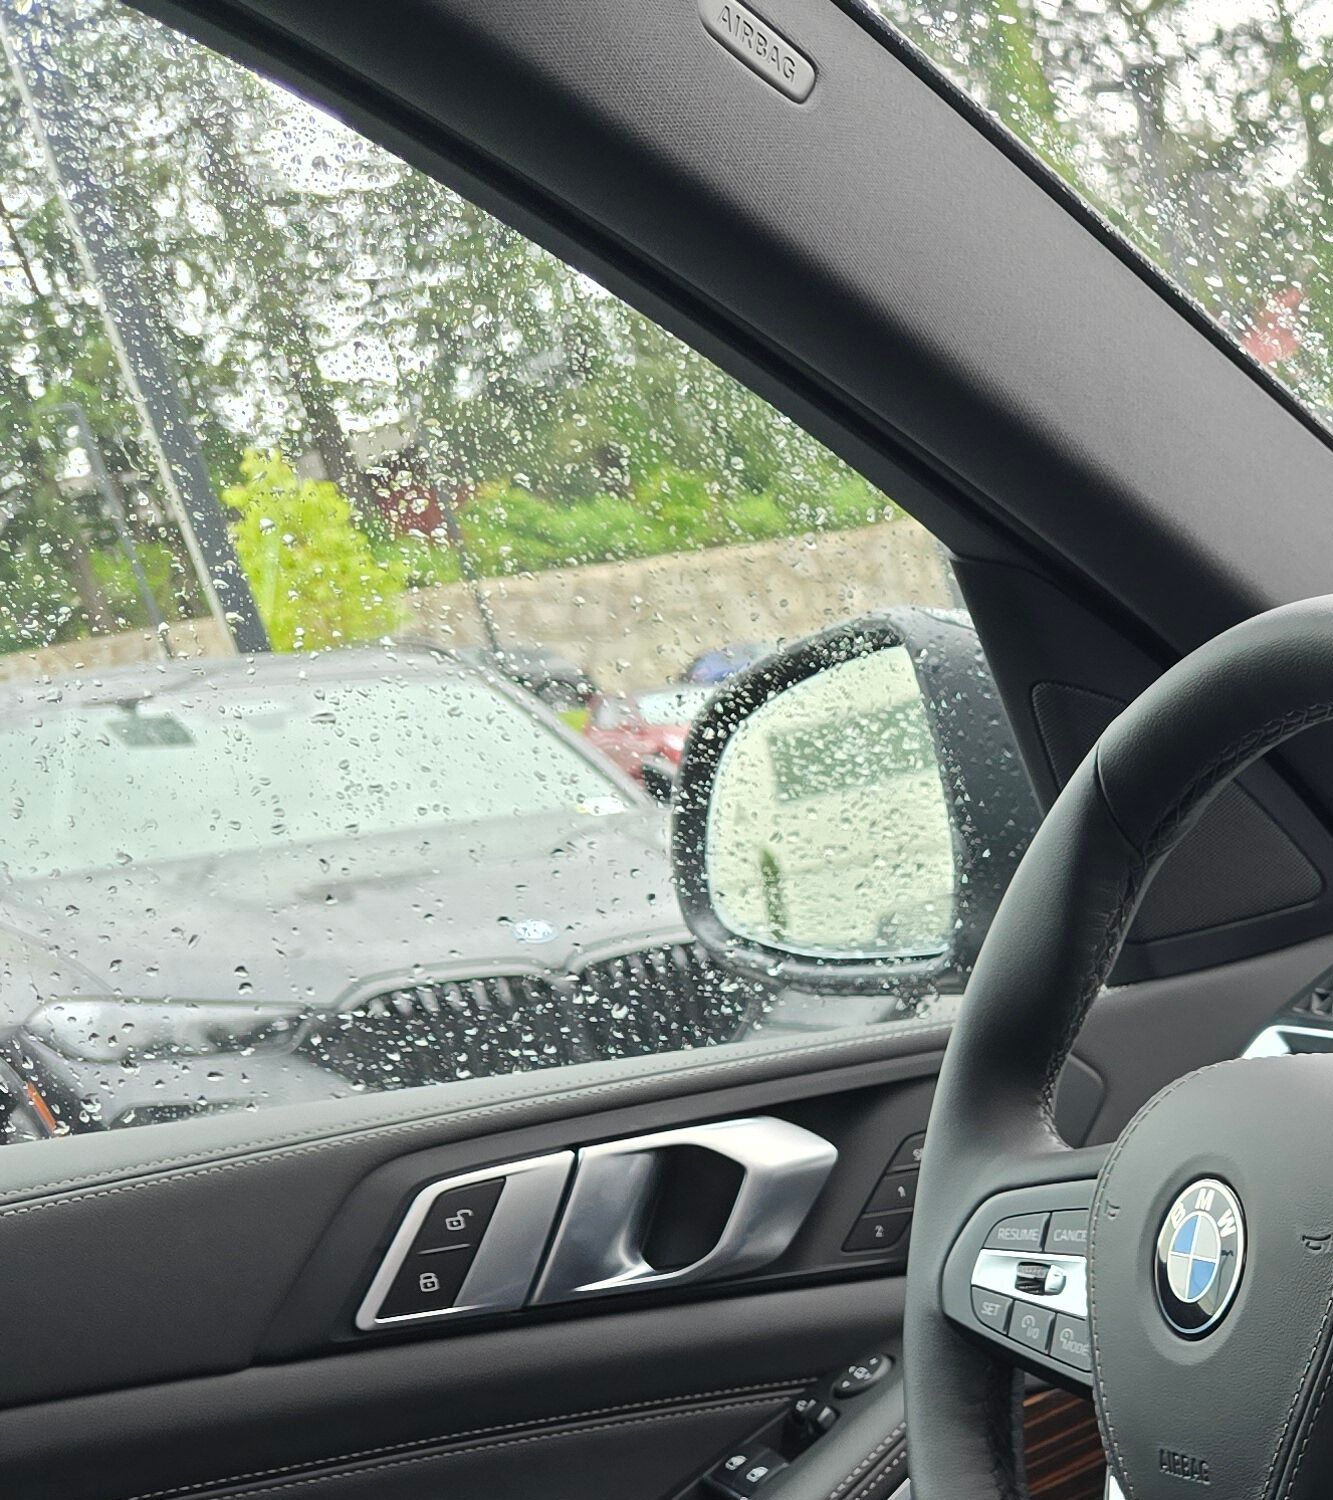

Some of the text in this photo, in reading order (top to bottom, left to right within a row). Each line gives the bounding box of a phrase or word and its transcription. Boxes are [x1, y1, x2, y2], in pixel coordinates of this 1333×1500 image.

[717, 4, 797, 83] AIRBAG
[997, 1227, 1088, 1242] RESUME CANCE
[981, 1302, 1000, 1316] SET
[1062, 1339, 1090, 1357] MODE
